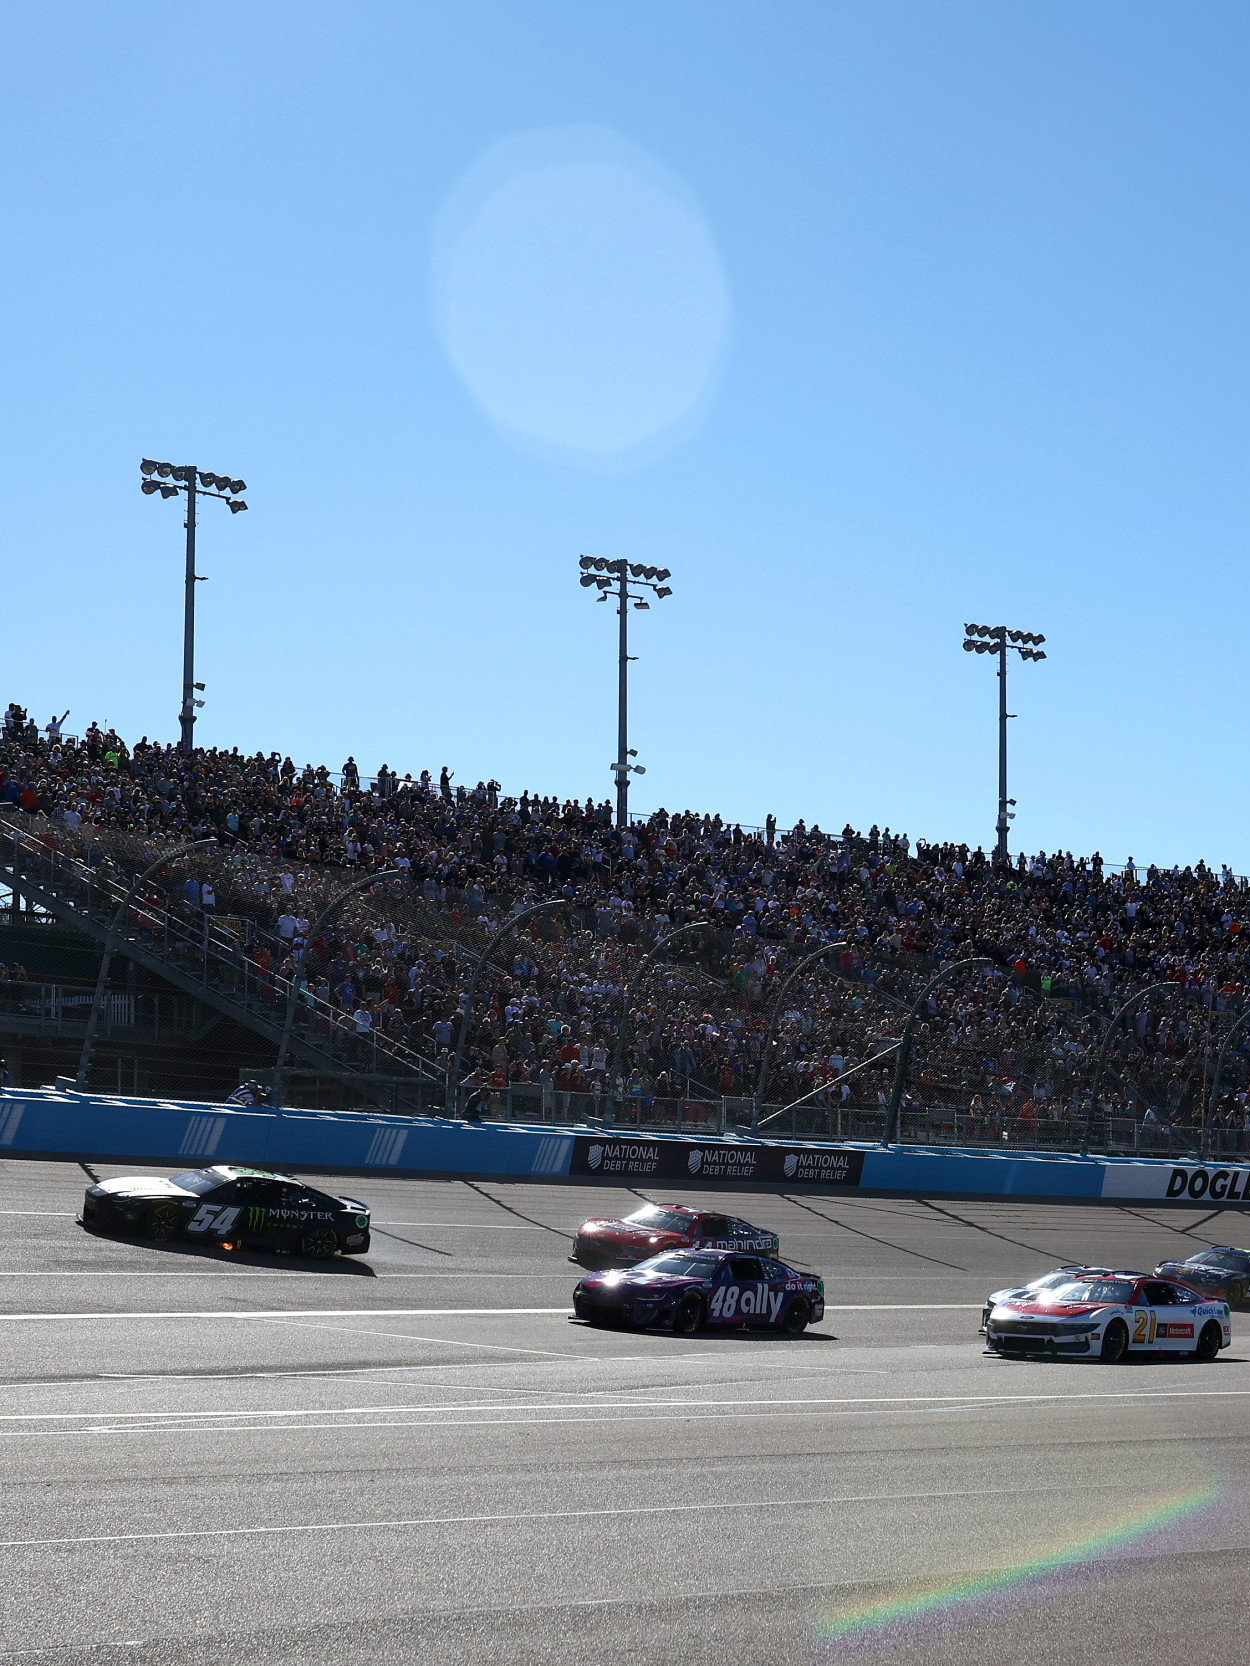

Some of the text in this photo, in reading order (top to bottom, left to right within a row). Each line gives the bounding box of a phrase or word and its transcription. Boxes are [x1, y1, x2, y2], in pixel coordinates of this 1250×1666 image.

[604, 1144, 660, 1161] NATIONAL
[703, 1150, 757, 1165] NATIONAL
[603, 1160, 657, 1173] DEBT RELIEF
[799, 1154, 850, 1169] NATIONAL
[702, 1164, 755, 1176] DEBT RELIEF
[797, 1168, 847, 1180] DEBT RELIEF
[187, 1203, 335, 1236] 54 MONSTER
[716, 1236, 771, 1250] mahindra
[711, 1285, 740, 1318] 48
[741, 1283, 783, 1323] ally
[785, 1281, 796, 1291] do
[1132, 1310, 1156, 1344] 21
